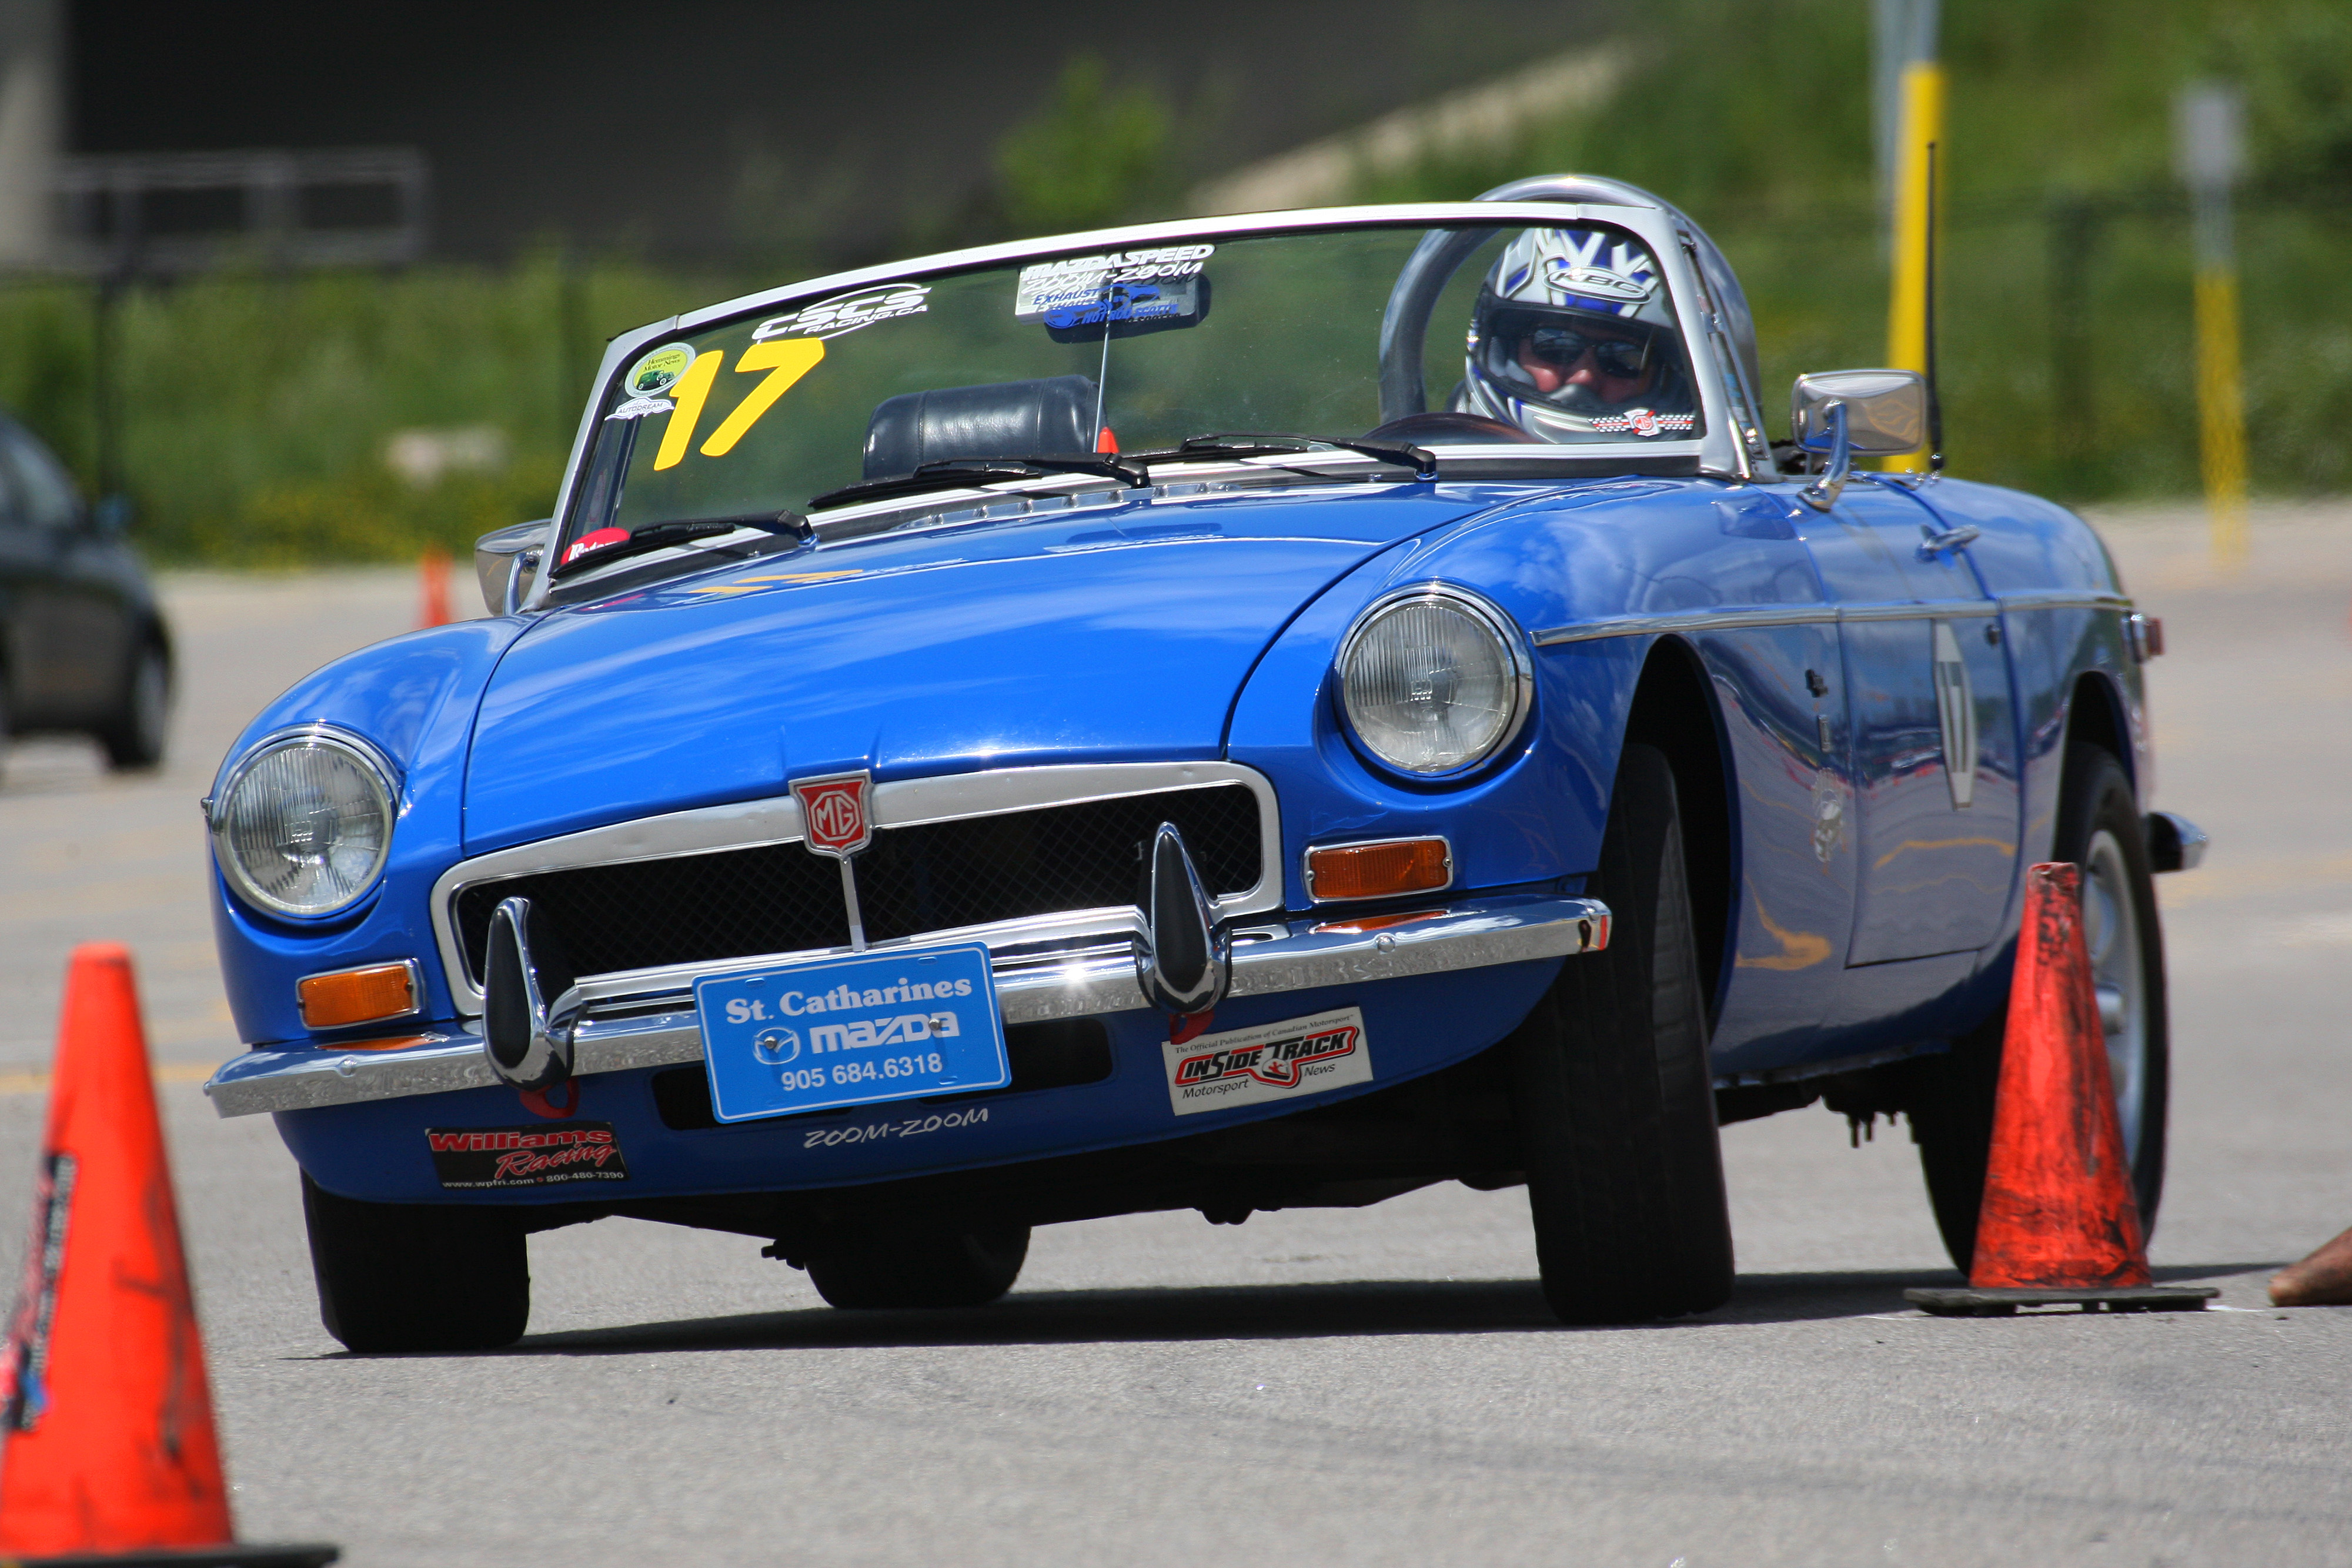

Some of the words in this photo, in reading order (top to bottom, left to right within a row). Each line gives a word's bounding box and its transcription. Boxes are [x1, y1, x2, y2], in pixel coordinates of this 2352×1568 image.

[1021, 261, 1204, 293] ZOOM-ZOOM
[1023, 244, 1215, 281] MAZDASPEED
[751, 287, 932, 340] CSCS
[1033, 289, 1100, 305] EXHAUST
[803, 305, 928, 334] RACING.CA
[619, 402, 663, 413] AUTODREAM
[654, 337, 824, 470] 17
[1635, 417, 1652, 428] MG
[816, 796, 854, 835] MG
[726, 998, 774, 1024] St.
[779, 978, 972, 1016] Catharines
[1190, 1041, 1218, 1051] Official
[1220, 1034, 1261, 1046] Publication
[1263, 1030, 1271, 1038] of
[1272, 1025, 1307, 1035] Canadian
[781, 1068, 825, 1091] 905
[832, 1053, 943, 1085] 684.6318
[1182, 1078, 1248, 1099] Motorsport
[1304, 1062, 1335, 1076] News
[429, 1130, 612, 1151] Williams
[803, 1108, 988, 1148] ZOOM-ZOOM
[494, 1142, 617, 1179] Racing
